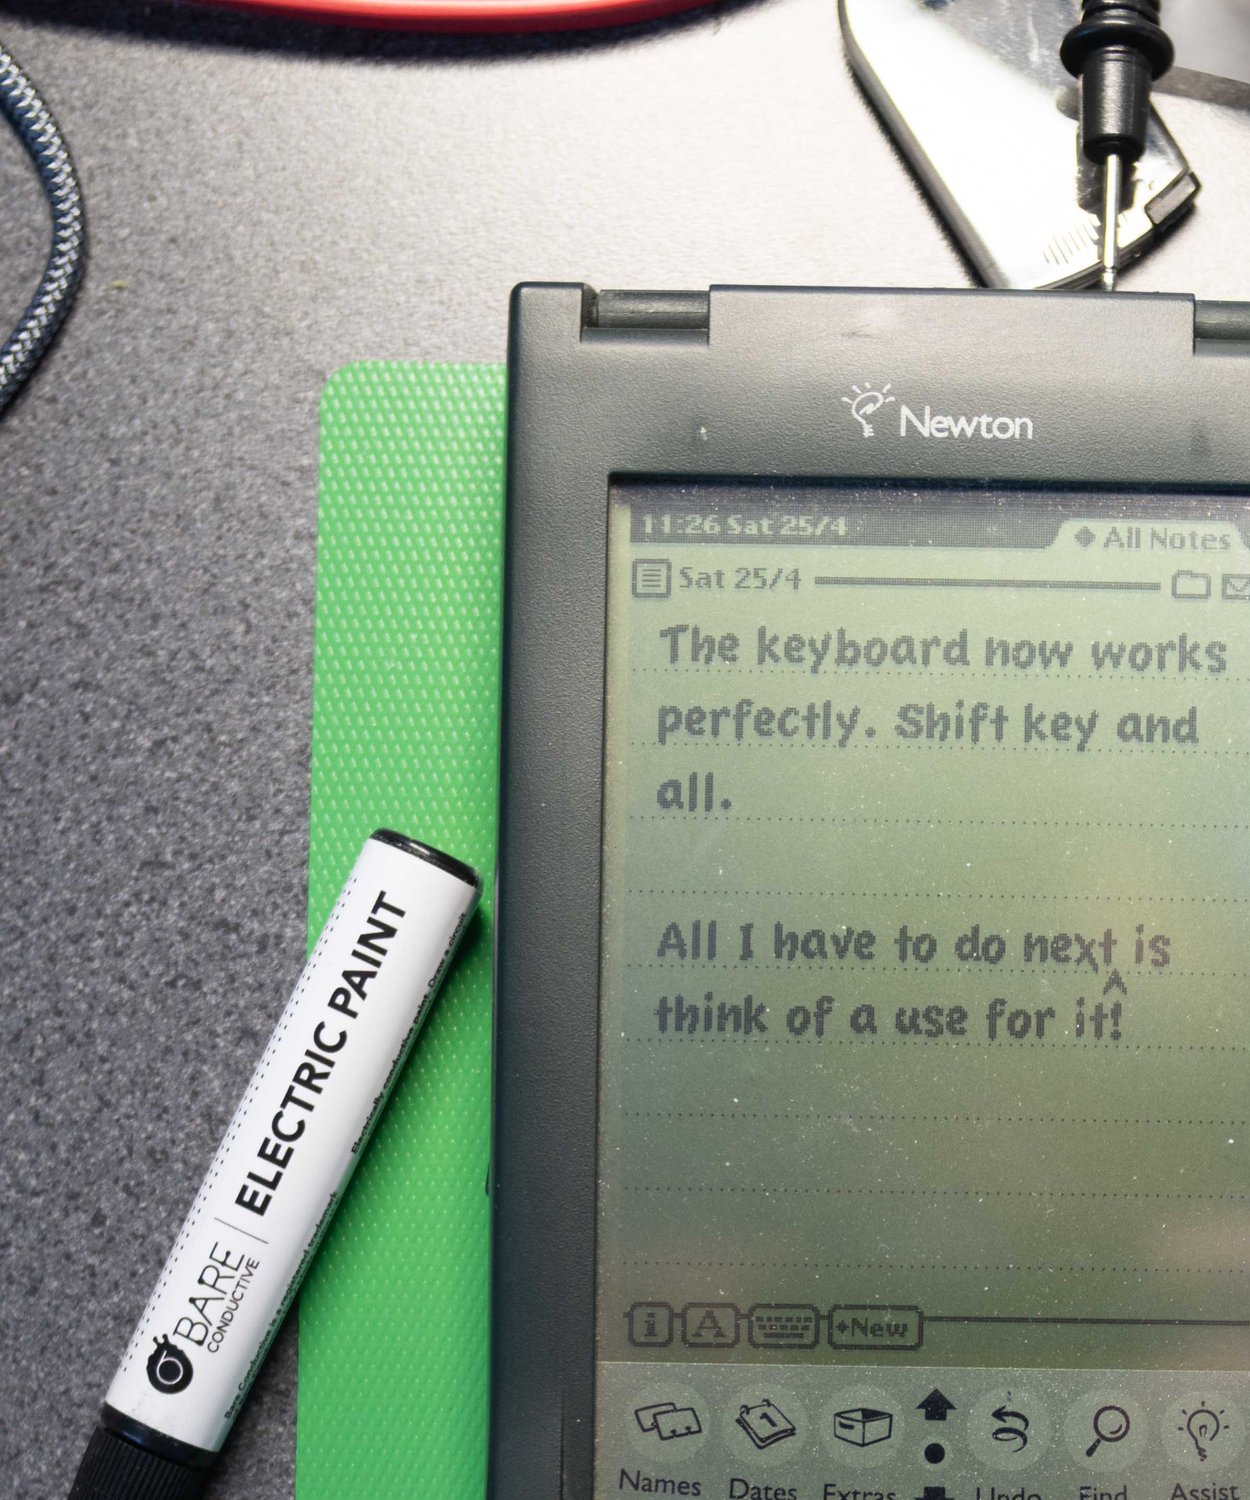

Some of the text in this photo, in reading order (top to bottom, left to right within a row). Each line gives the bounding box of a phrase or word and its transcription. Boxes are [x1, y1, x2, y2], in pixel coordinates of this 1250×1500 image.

[900, 406, 1033, 440] Newton
[641, 515, 846, 537] 11:26 Sat 25/4
[1103, 527, 1232, 551] All Notes
[678, 568, 802, 591] Sat 25/4
[659, 624, 1228, 674] The keyboard now works
[658, 699, 1200, 751] perfectly. Shift key and
[656, 771, 732, 812] all.
[656, 920, 1171, 972] All I have to do next is
[349, 1089, 386, 1154] Electrically
[379, 1025, 416, 1090] conductive
[426, 956, 447, 988] Draw
[445, 911, 467, 947] circuit
[655, 993, 1123, 1041] think of a use for it!
[234, 890, 406, 1217] ELECTRIC PAINT
[173, 1241, 245, 1347] BARE
[207, 1258, 260, 1353] CONDUCTIVE
[223, 1392, 241, 1420] Bare
[236, 1328, 272, 1392] Conductive
[305, 1189, 339, 1248] trademark
[619, 1469, 701, 1498] Names
